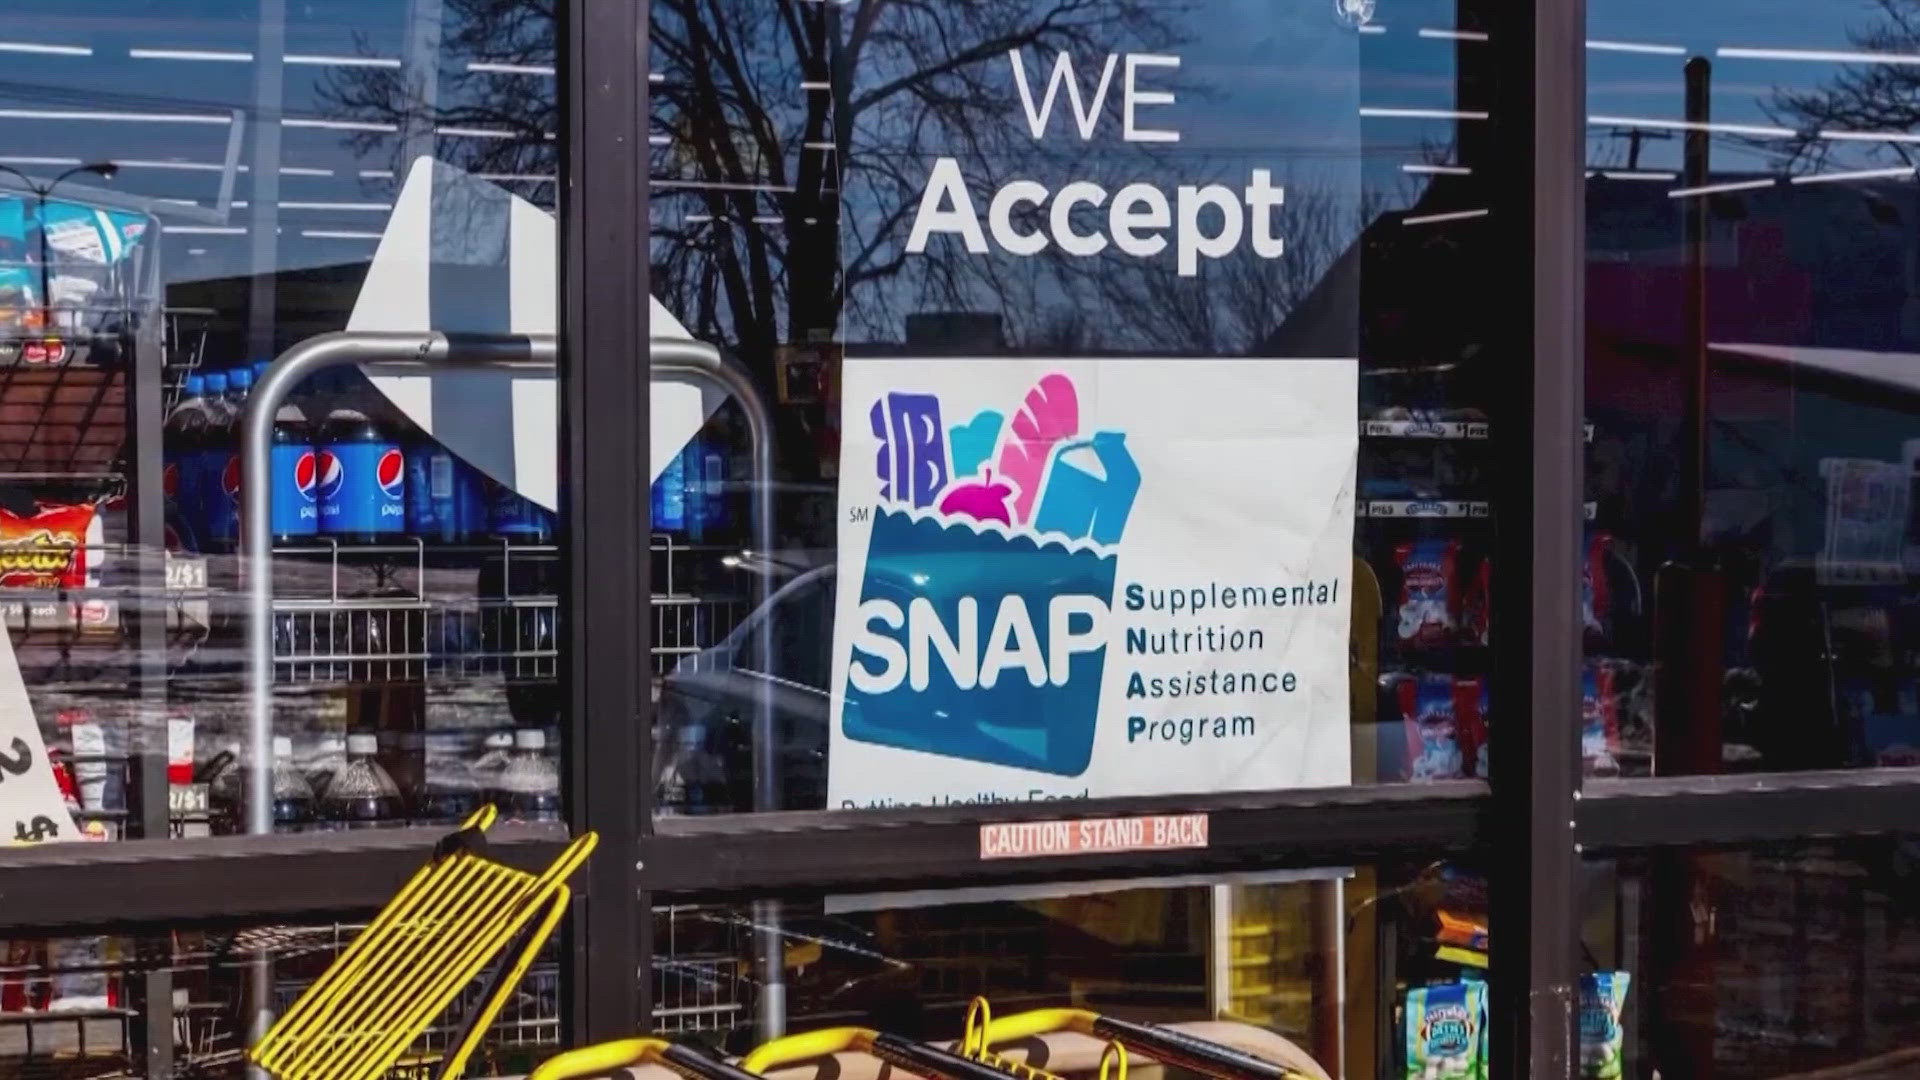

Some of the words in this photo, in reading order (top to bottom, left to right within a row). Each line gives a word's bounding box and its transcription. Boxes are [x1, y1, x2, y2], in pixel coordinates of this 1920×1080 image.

[1008, 48, 1181, 142] WE
[904, 157, 1285, 277] Accept
[849, 506, 869, 523] SM
[1125, 578, 1339, 616] Supplemental
[849, 594, 1110, 695] SNAP
[1126, 625, 1264, 655] Nutrition
[1126, 669, 1298, 700] Assistance
[1128, 715, 1256, 746] Program
[984, 822, 1070, 854] CAUTION
[1079, 818, 1144, 849] STAND
[1153, 814, 1205, 845] BACK
